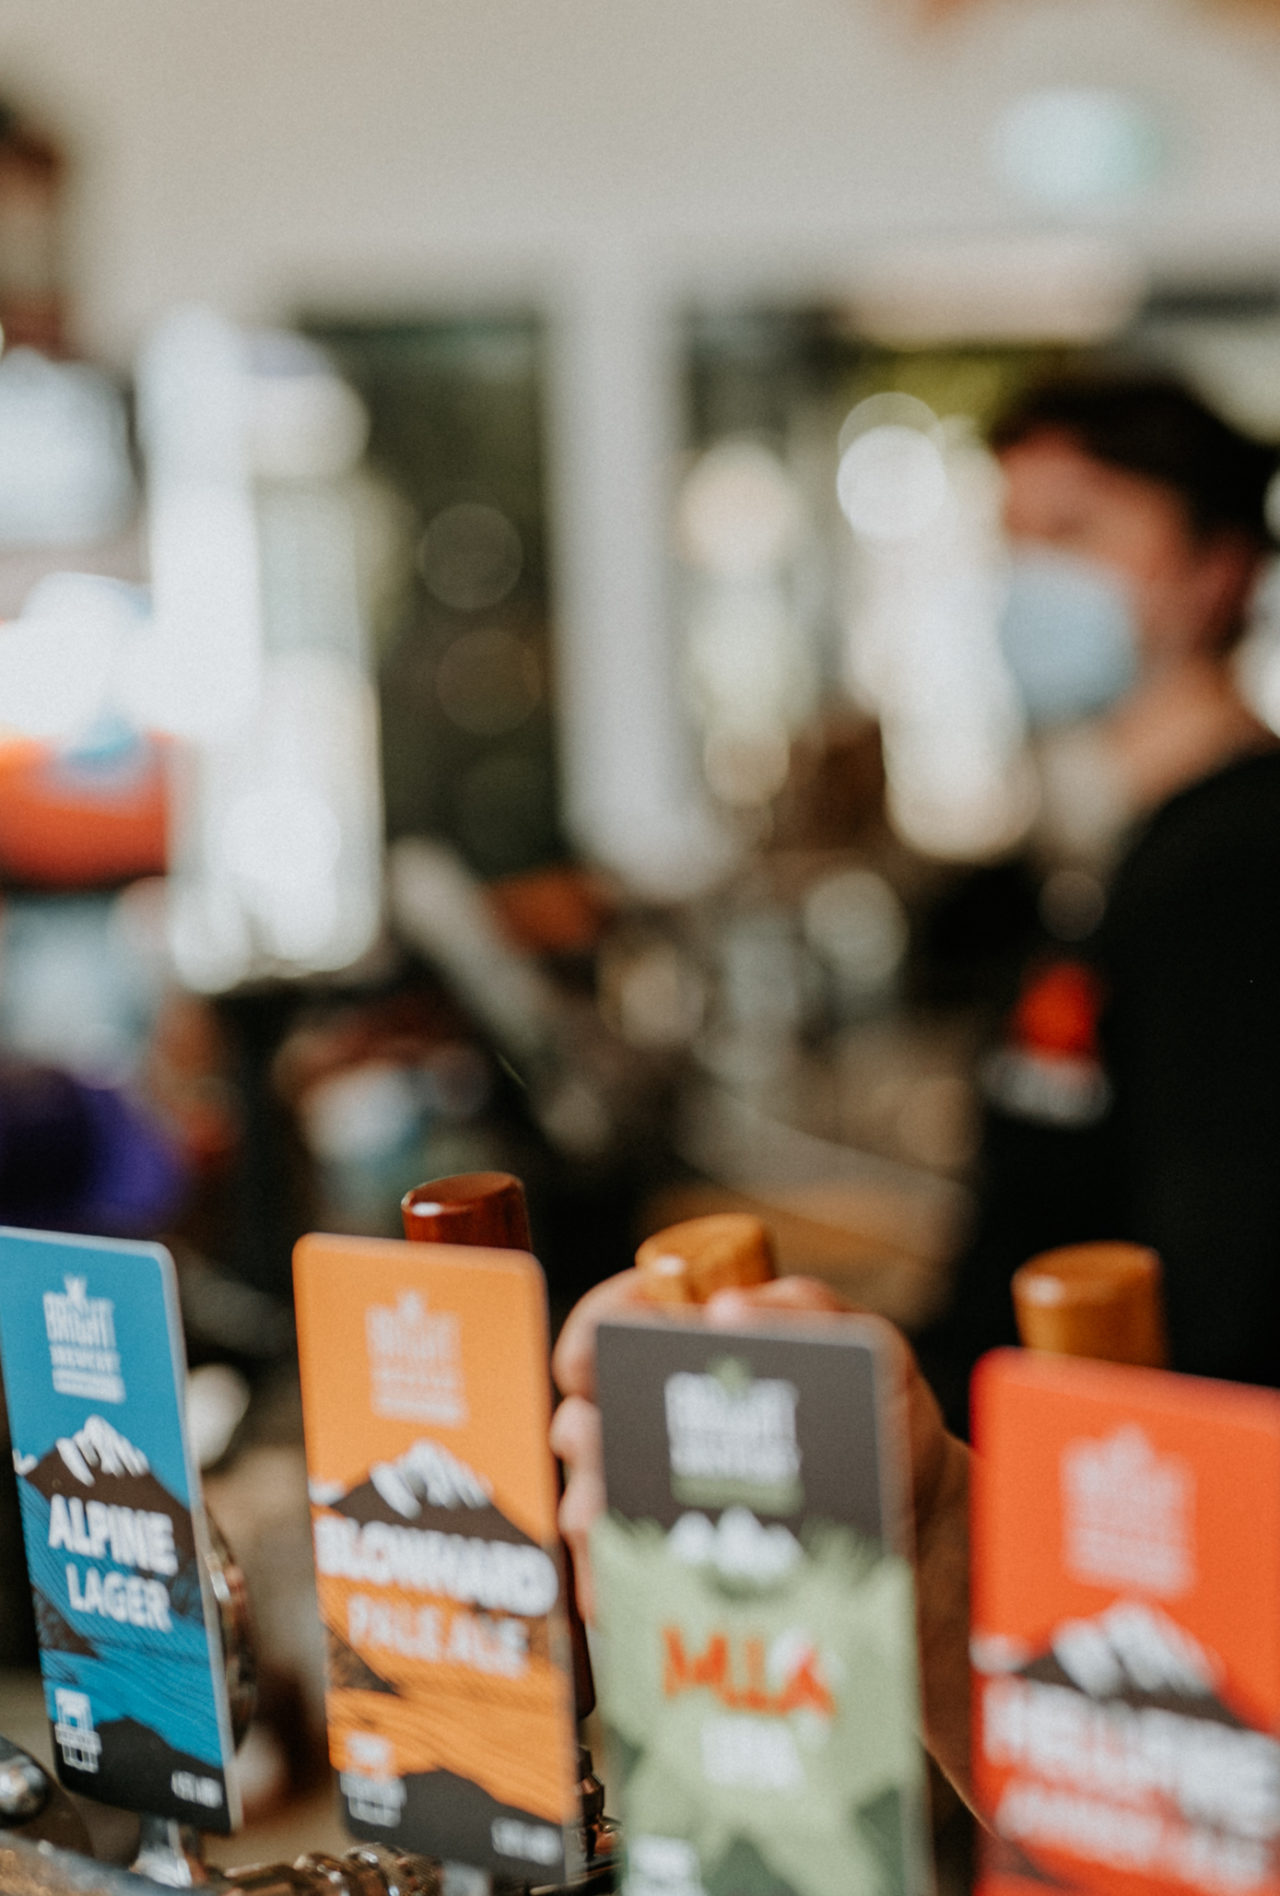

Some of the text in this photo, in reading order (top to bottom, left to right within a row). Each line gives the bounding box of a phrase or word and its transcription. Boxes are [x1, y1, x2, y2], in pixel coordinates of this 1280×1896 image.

[49, 1493, 178, 1576] ALPINE
[65, 1562, 173, 1632] LAGER
[348, 1595, 530, 1679] PALE ALE
